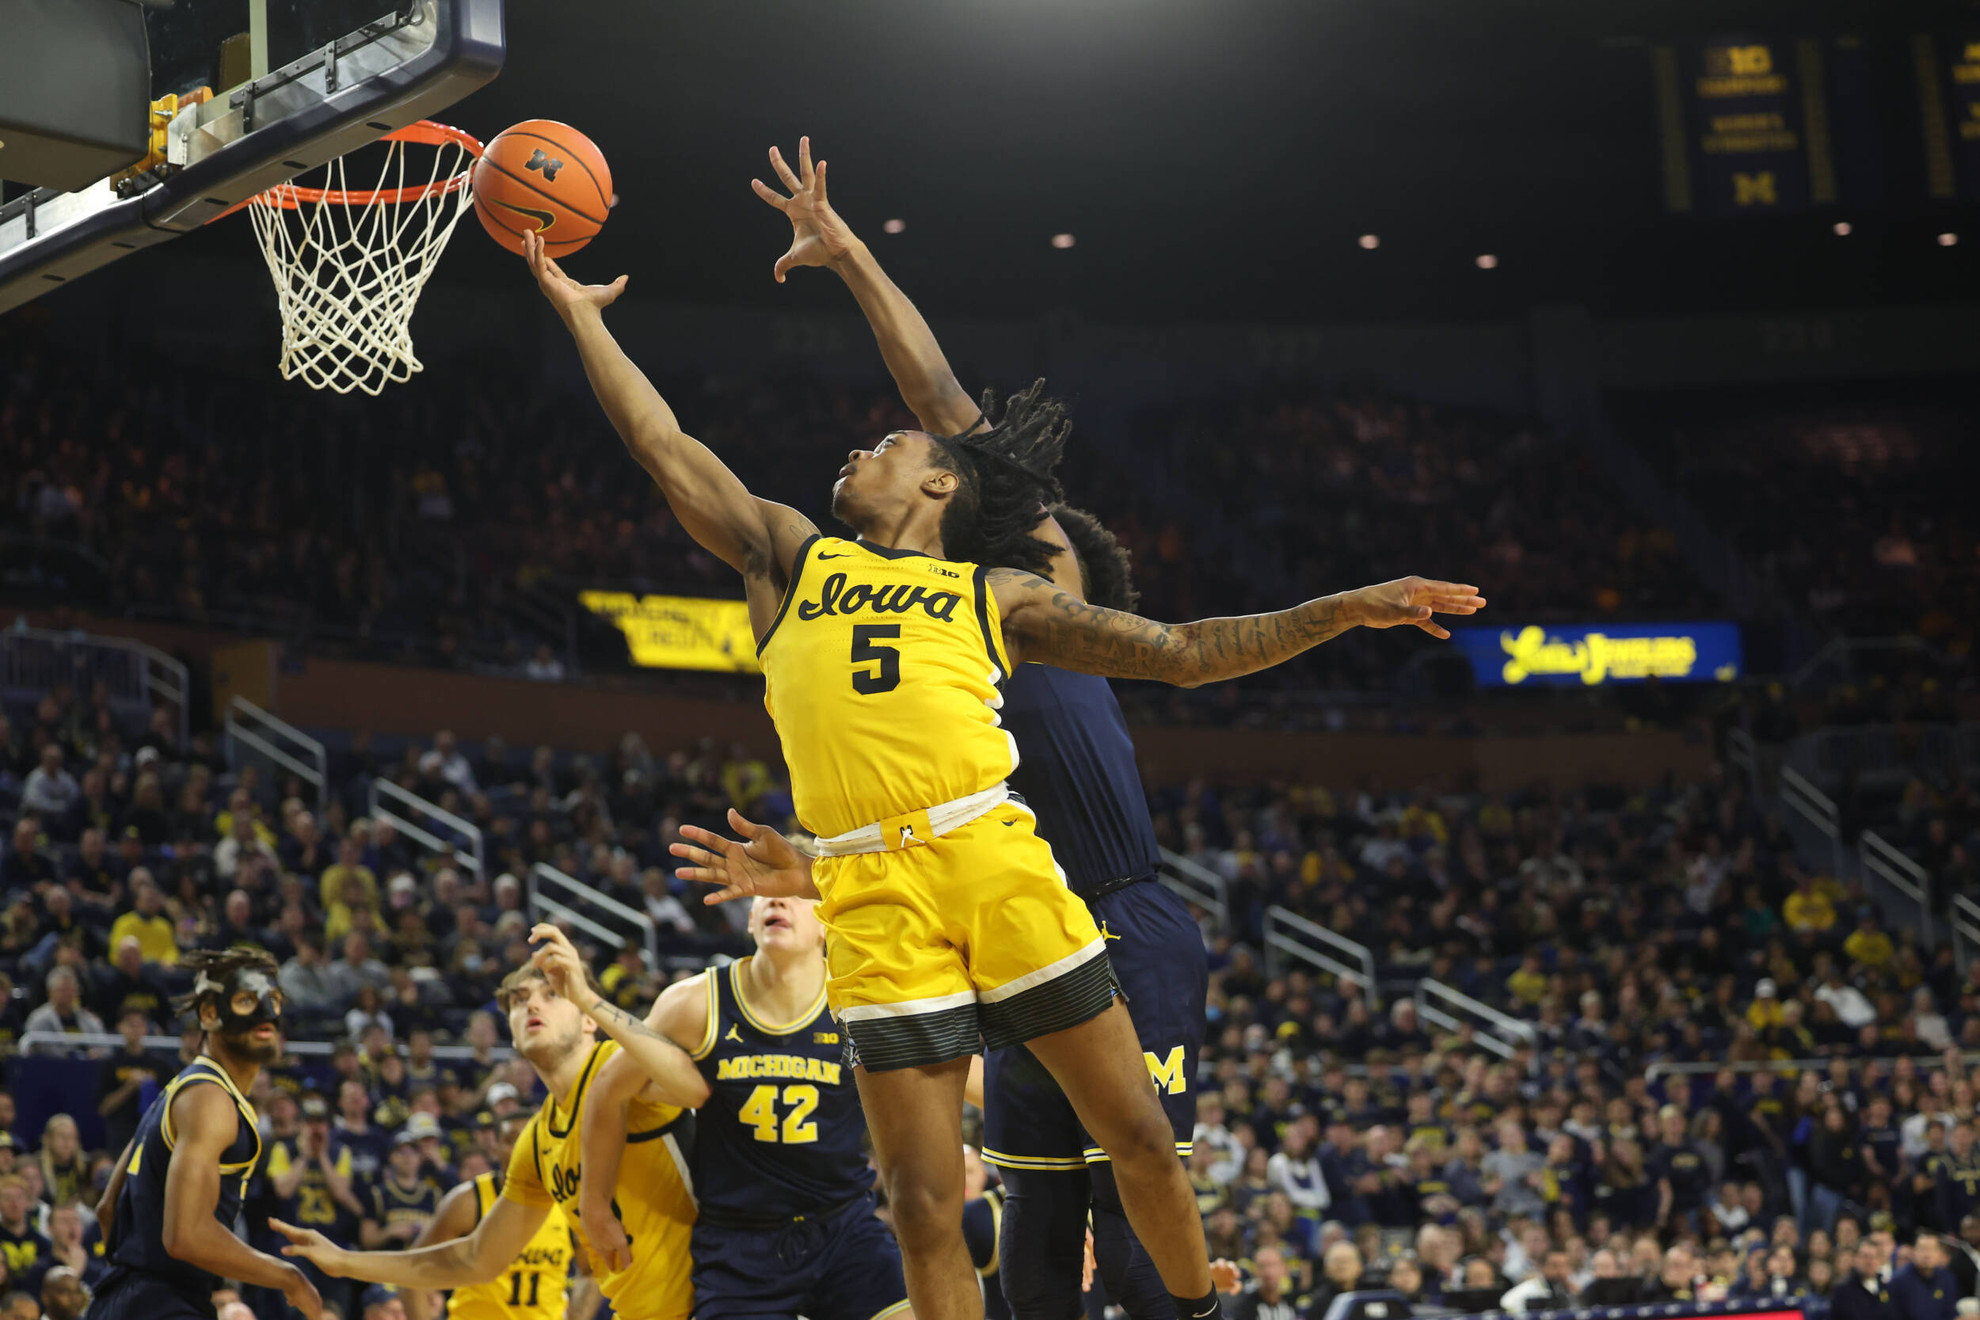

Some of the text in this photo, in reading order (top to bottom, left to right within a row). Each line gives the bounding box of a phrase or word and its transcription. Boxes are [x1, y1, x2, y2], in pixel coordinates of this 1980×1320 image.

[525, 148, 564, 182] M
[798, 572, 962, 622] Iowa
[850, 623, 901, 695] 5
[717, 1054, 842, 1086] MICHIGAN
[1143, 1045, 1186, 1096] M
[738, 1084, 820, 1144] 42
[506, 1270, 540, 1307] 11
